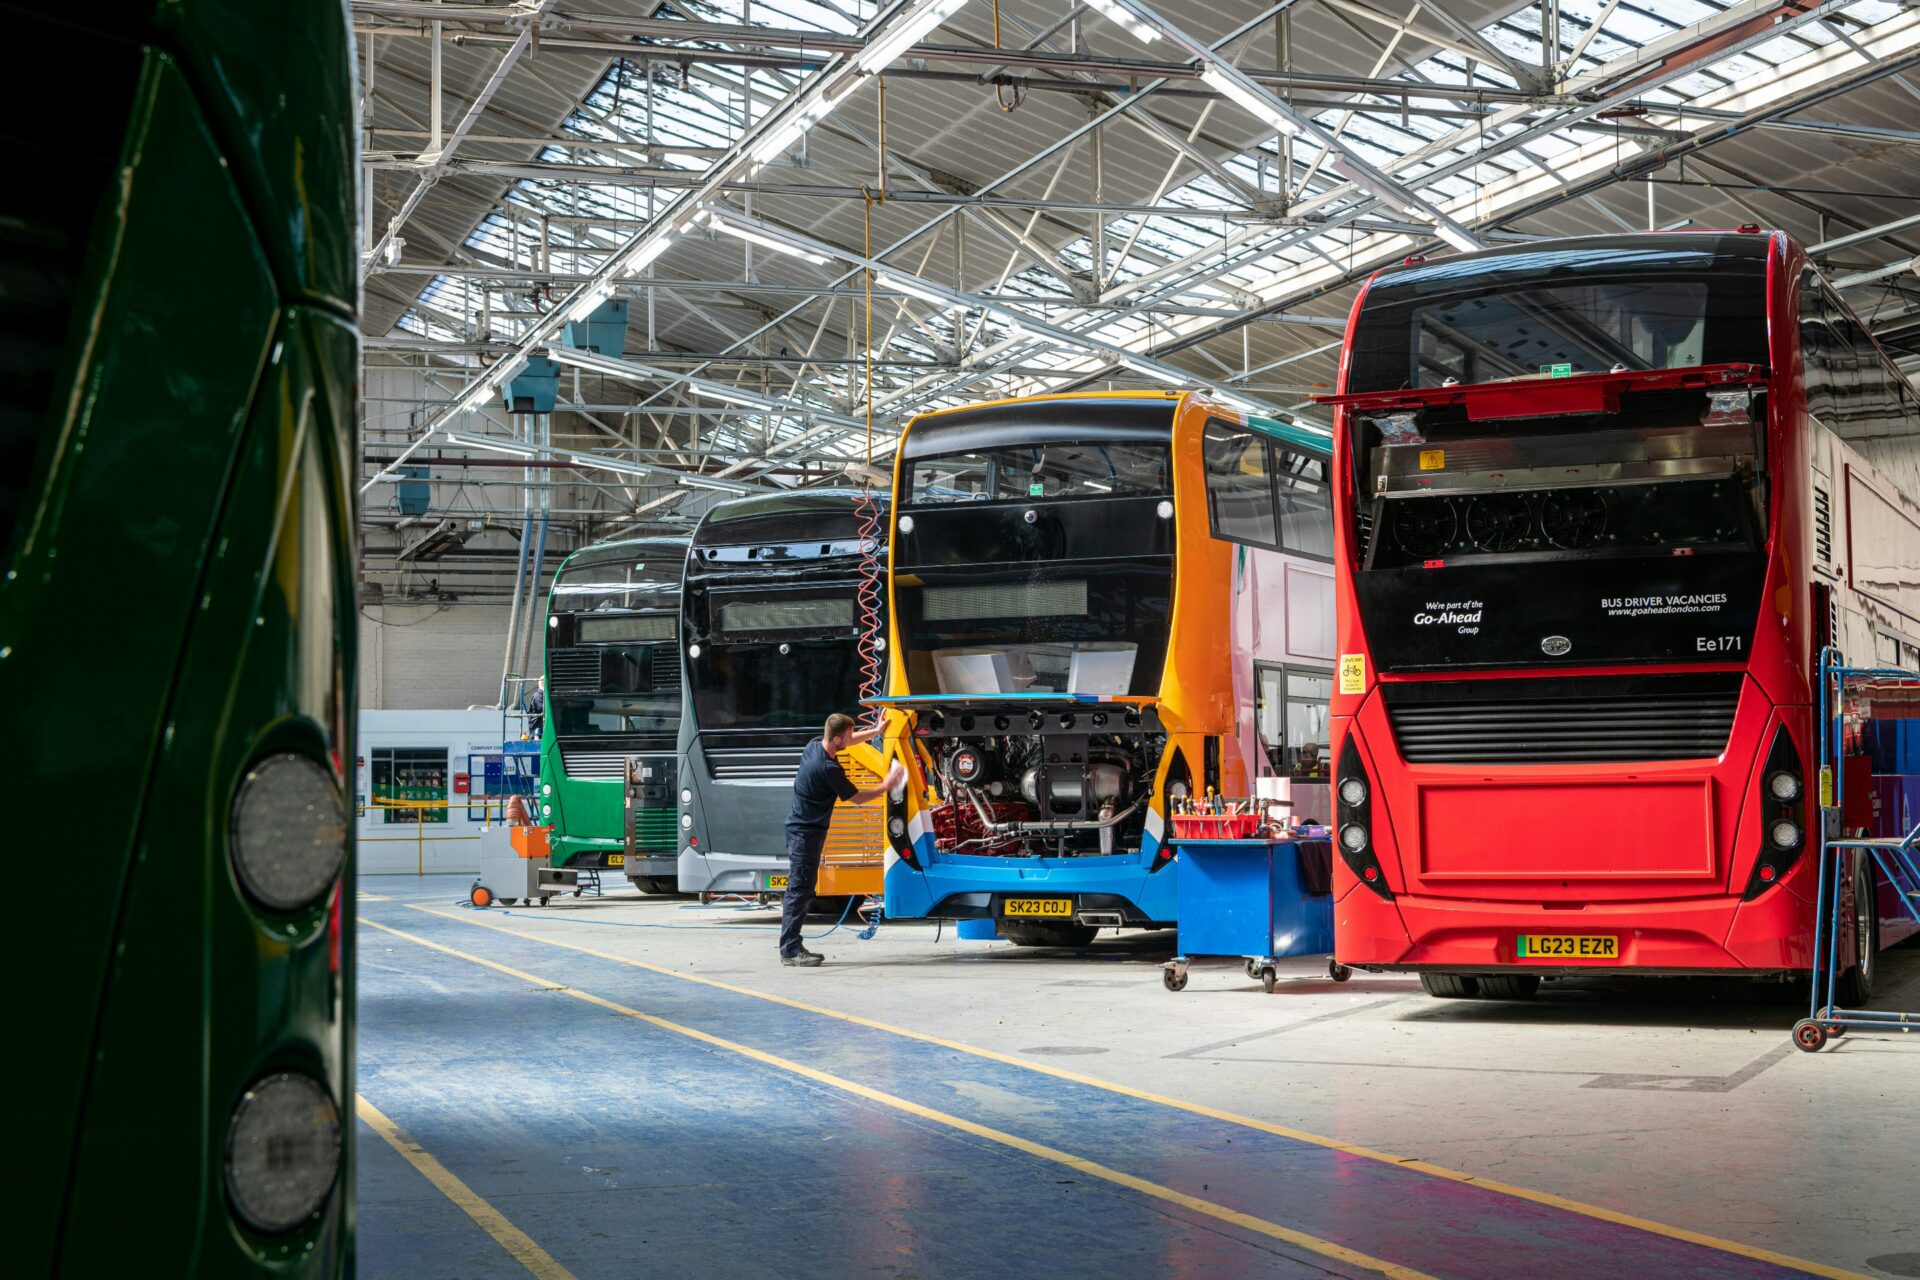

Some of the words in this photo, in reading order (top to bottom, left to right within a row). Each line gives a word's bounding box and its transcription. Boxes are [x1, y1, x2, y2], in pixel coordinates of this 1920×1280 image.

[1426, 602, 1445, 610] We're
[1446, 602, 1461, 611] part
[1462, 600, 1471, 610] of
[1601, 598, 1622, 608] BUS
[1625, 596, 1663, 607] DRIVER
[1666, 593, 1727, 605] VACANCIES
[1608, 604, 1720, 617] www.goaheadlondon.com
[1414, 610, 1482, 625] Go-Ahead
[1457, 626, 1479, 635] Group
[1697, 636, 1742, 652] Ee171
[771, 876, 788, 886] SK2
[1010, 901, 1040, 913] SK23
[1043, 901, 1067, 913] COJ
[1529, 937, 1575, 954] LG23
[1579, 938, 1614, 955] EZR
